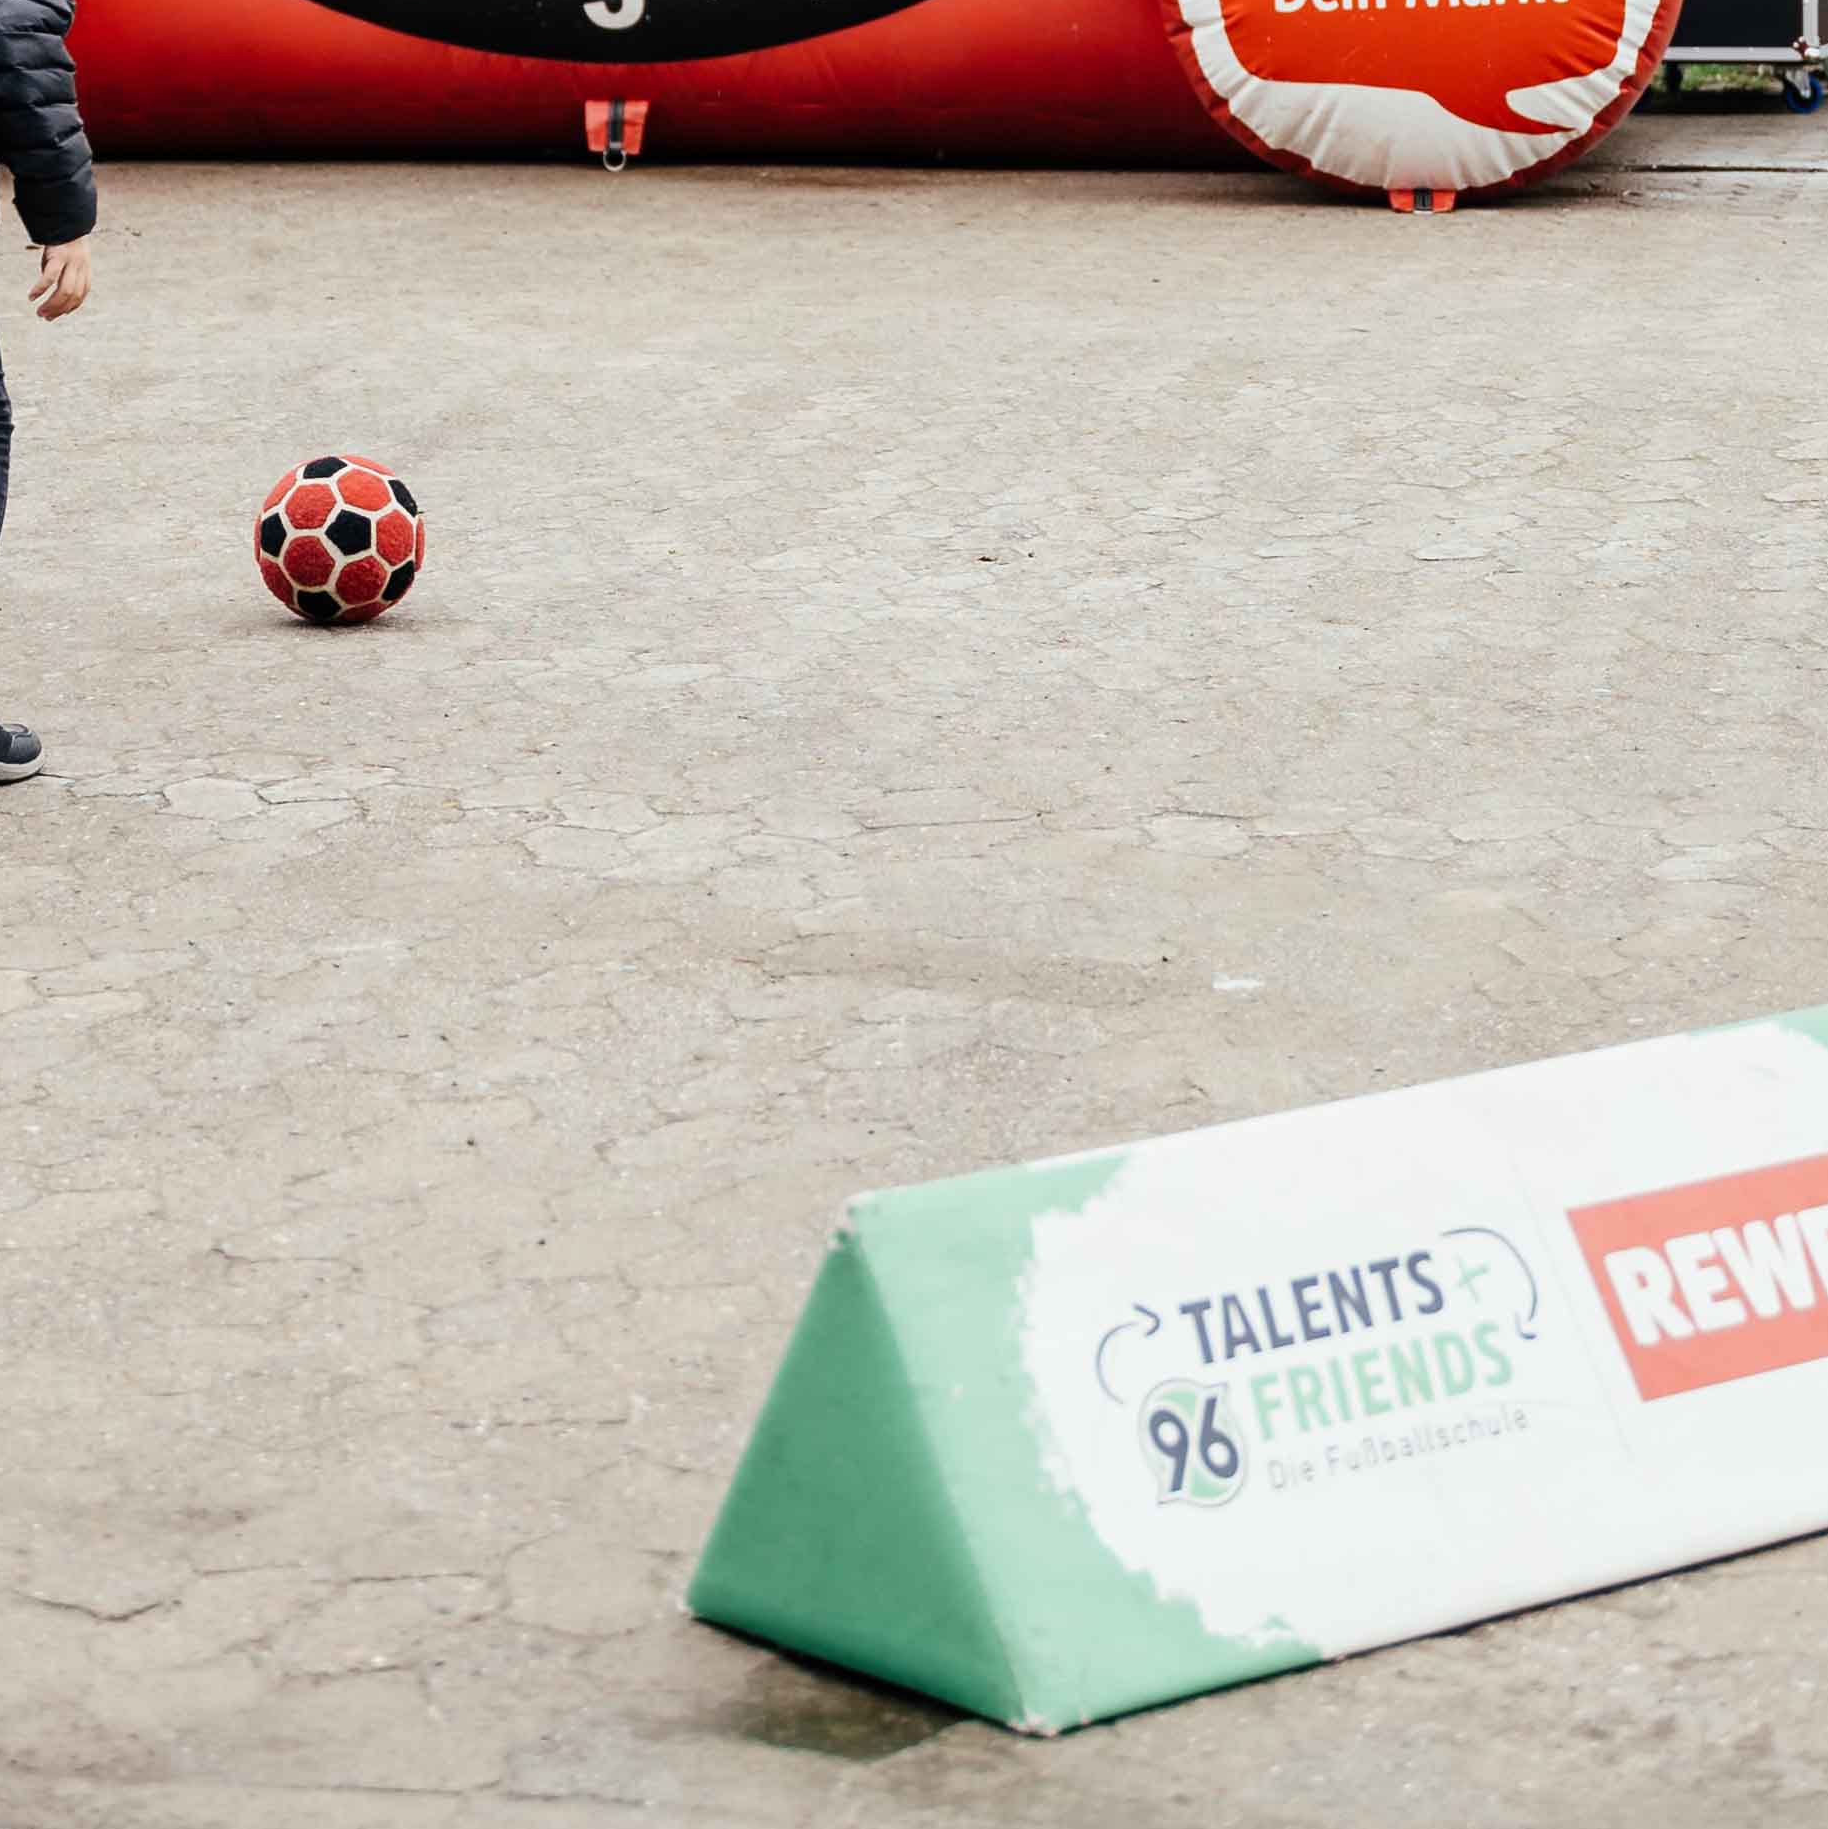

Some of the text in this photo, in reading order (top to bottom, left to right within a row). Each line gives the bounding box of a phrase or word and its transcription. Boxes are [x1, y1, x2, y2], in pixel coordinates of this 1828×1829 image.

[1179, 1249, 1445, 1365] TALENTS
[1149, 1322, 1515, 1493] 96 FRIENDS
[1268, 1406, 1529, 1491] Die Fußballschule
